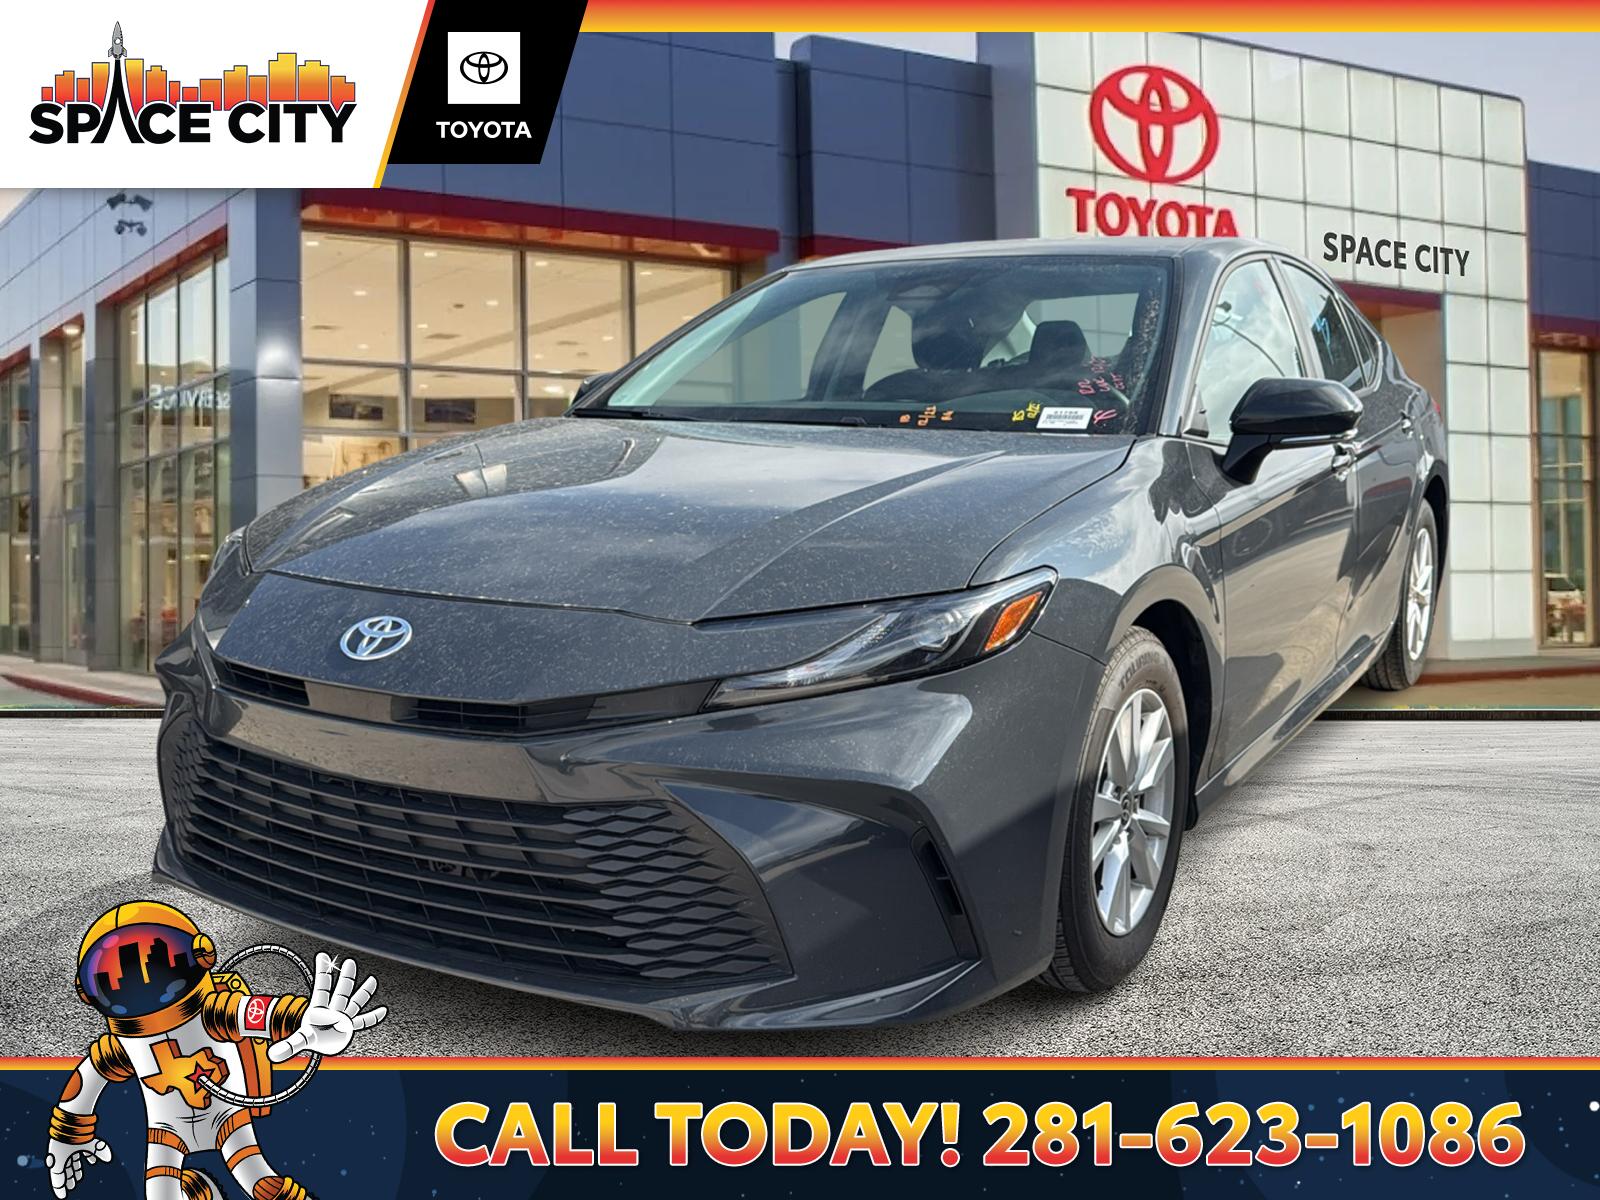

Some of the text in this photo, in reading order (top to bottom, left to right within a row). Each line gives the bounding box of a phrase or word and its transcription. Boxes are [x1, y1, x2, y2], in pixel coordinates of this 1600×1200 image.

[1066, 188, 1239, 238] TOYOTA
[1323, 231, 1470, 277] SPACE CITY
